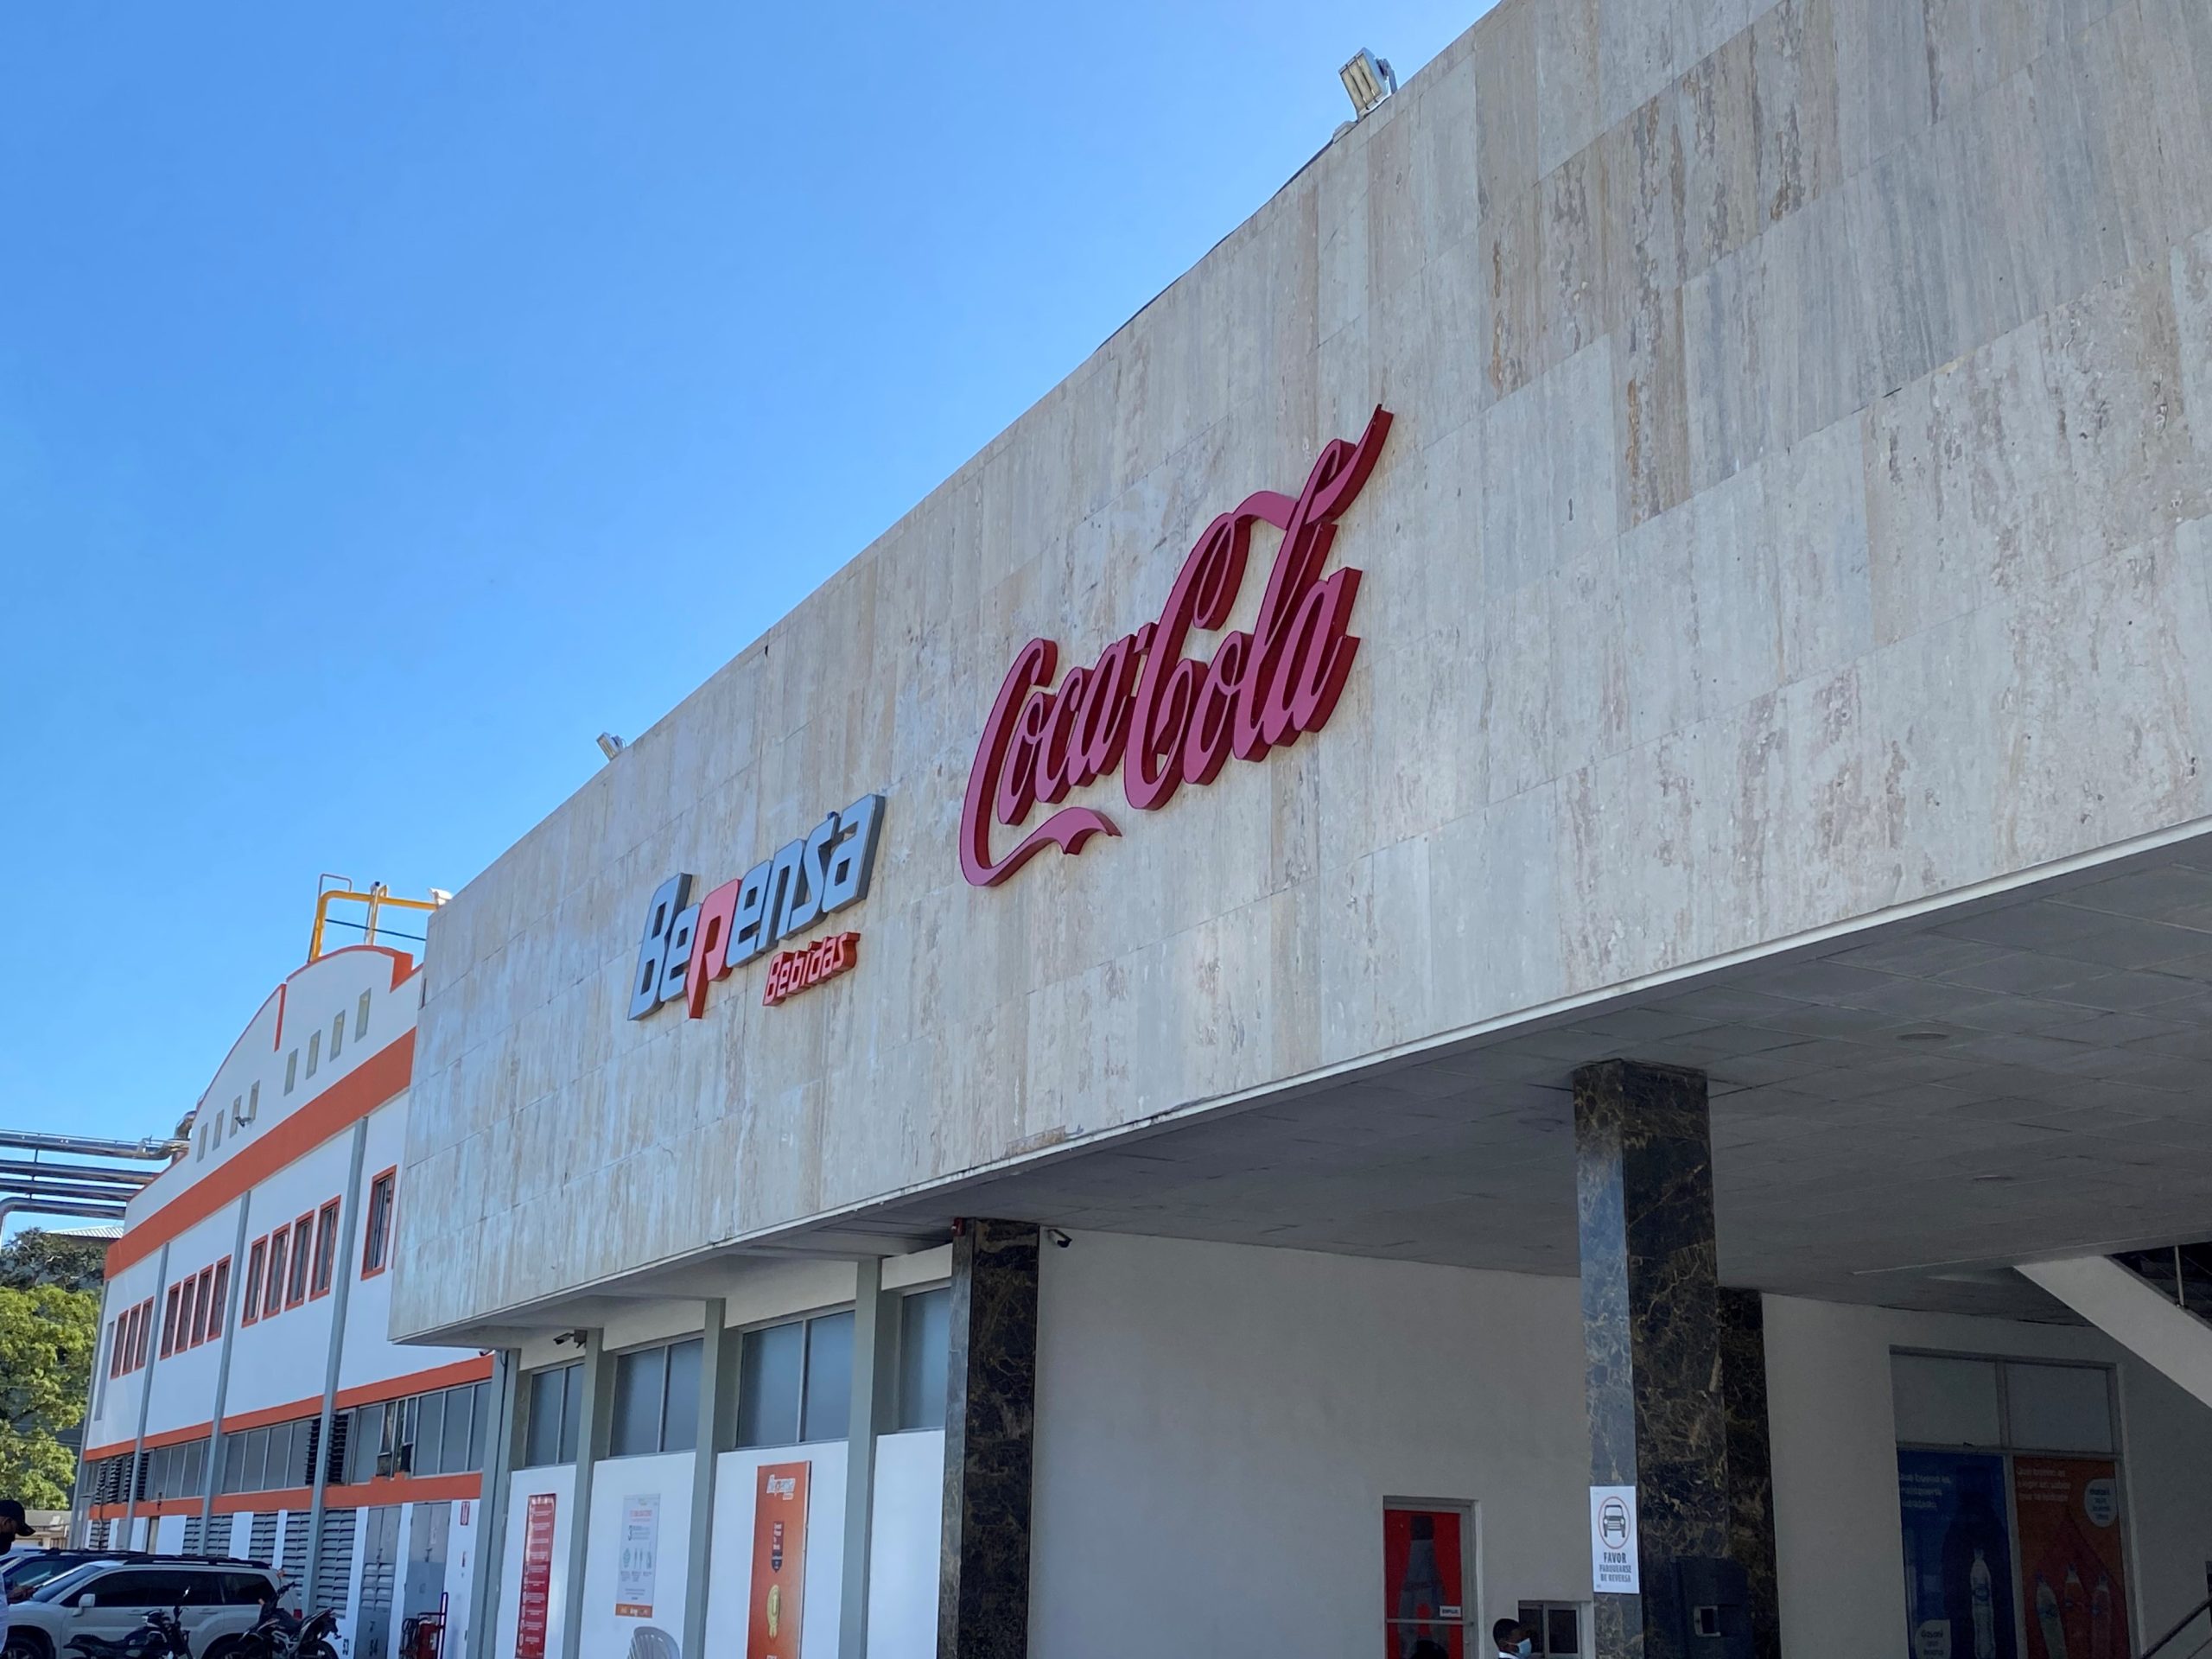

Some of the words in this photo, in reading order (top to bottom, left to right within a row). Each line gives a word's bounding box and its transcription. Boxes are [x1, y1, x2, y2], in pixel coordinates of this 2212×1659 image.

[627, 794, 886, 1021] Bepensa
[762, 932, 861, 1007] Bebidas
[1604, 1552, 1627, 1563] FAVOR
